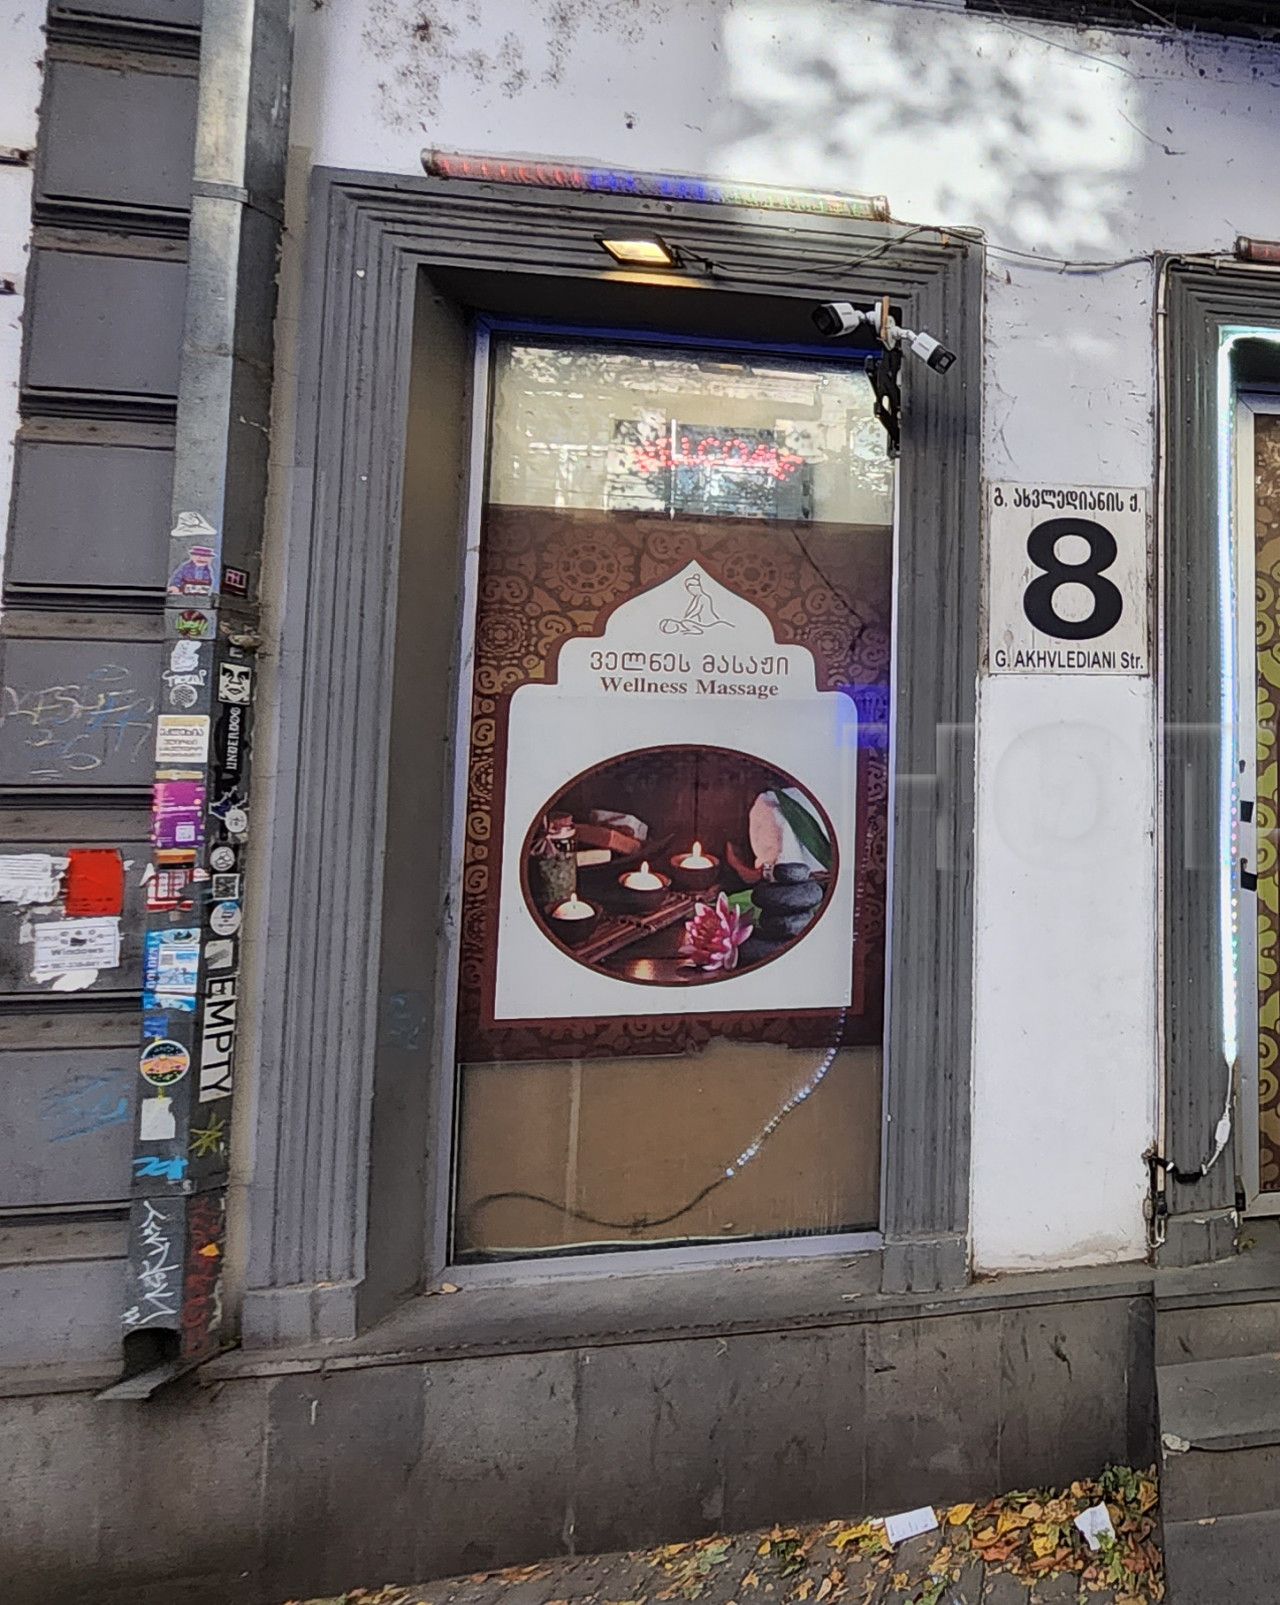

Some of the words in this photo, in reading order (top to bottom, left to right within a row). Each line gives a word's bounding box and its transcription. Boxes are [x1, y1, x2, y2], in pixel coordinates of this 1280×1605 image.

[994, 488, 1008, 507] გ.
[1013, 489, 1124, 511] ახვლედიანის
[1129, 493, 1141, 513] ქ.
[1023, 517, 1123, 640] 8
[590, 651, 690, 673] ველნეს
[702, 653, 789, 675] მასაჟი
[995, 650, 1010, 668] G.
[1014, 651, 1116, 669] AKHVLEDIANI
[1120, 652, 1144, 669] Str.
[600, 677, 687, 694] Wellness
[696, 679, 779, 699] Massage
[202, 977, 236, 1093] EMPTY
